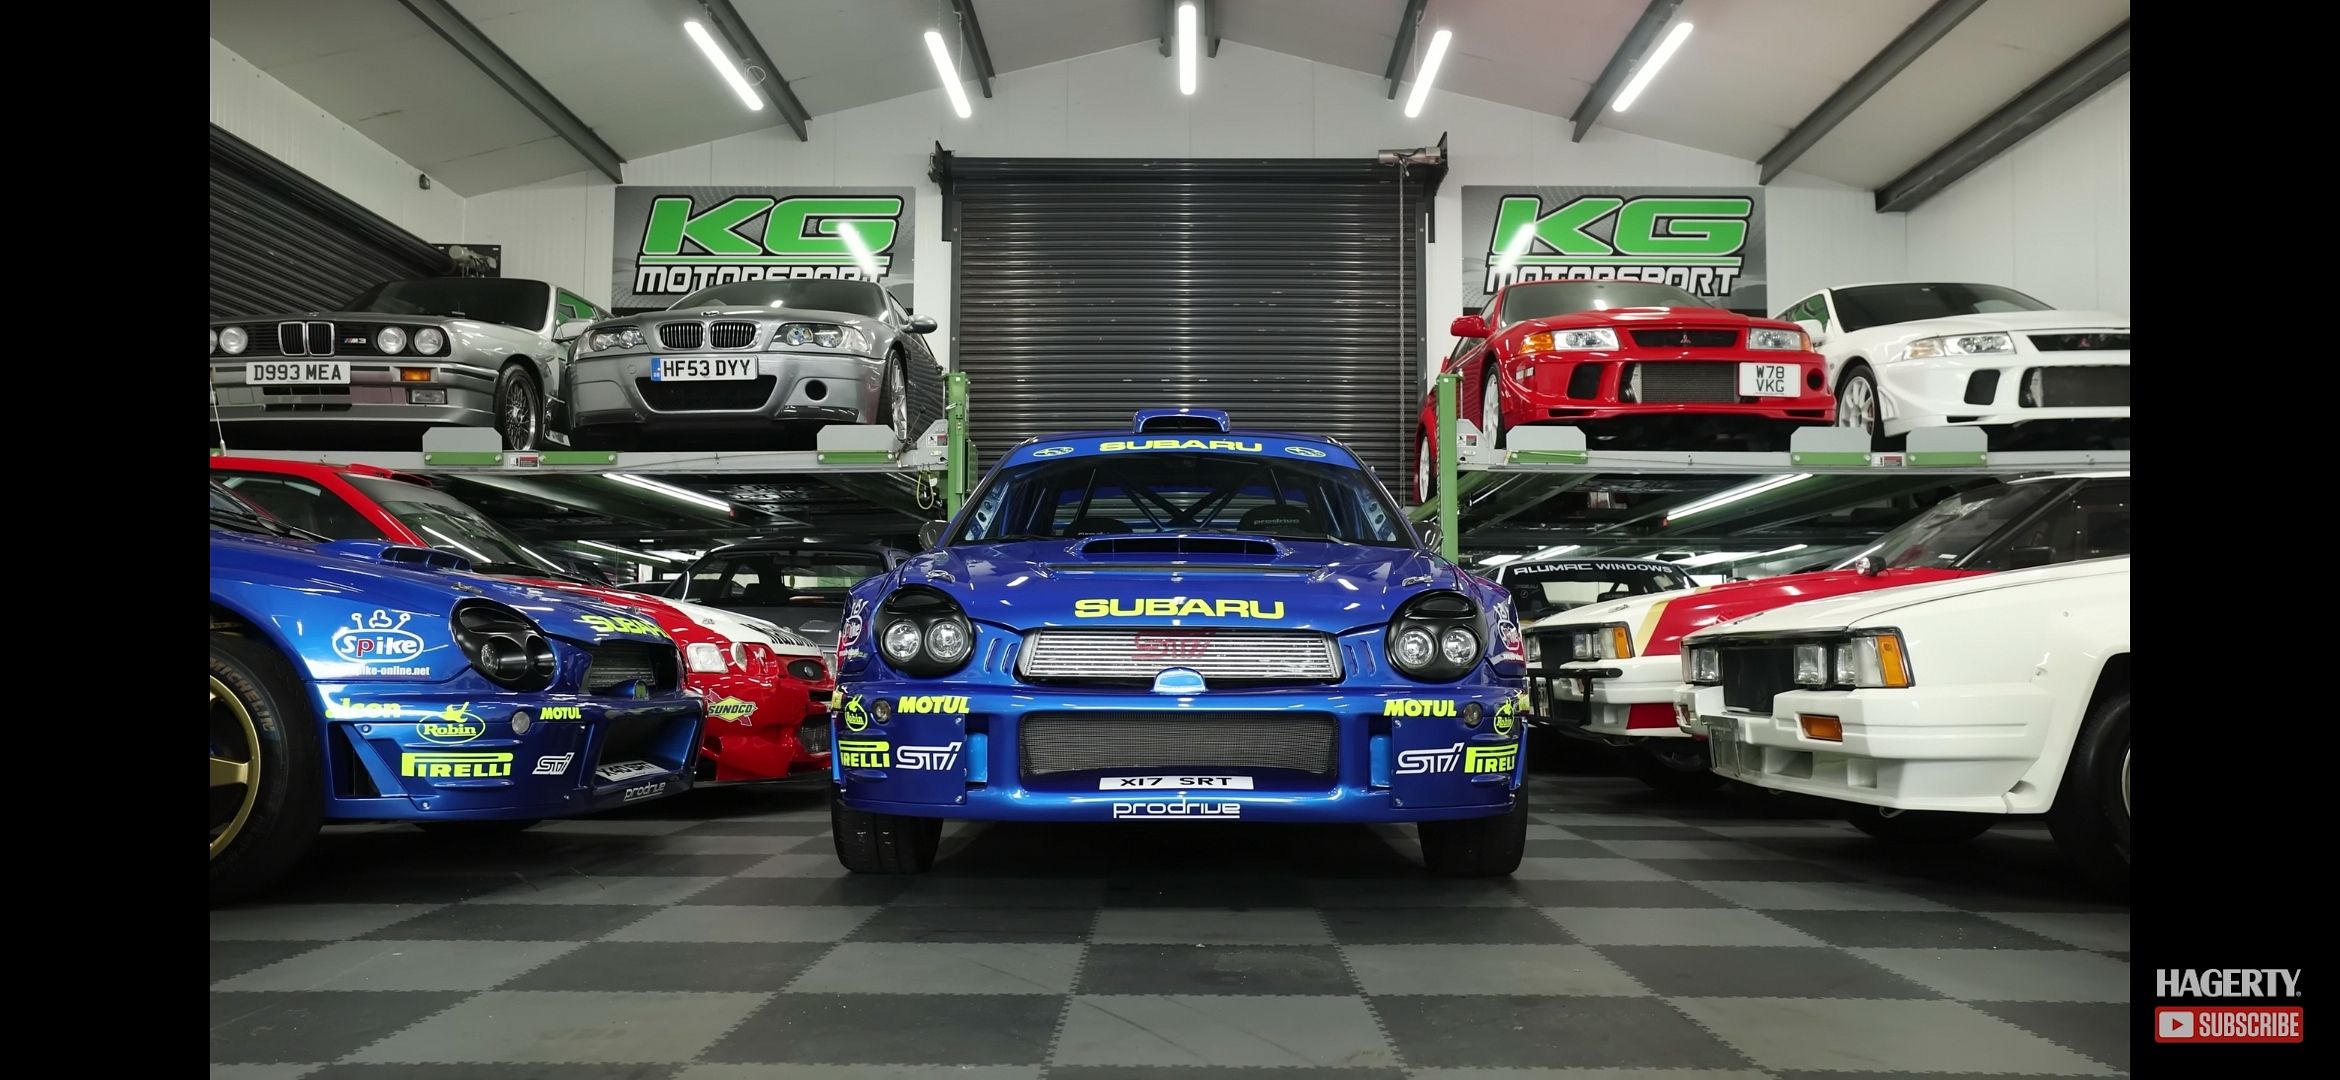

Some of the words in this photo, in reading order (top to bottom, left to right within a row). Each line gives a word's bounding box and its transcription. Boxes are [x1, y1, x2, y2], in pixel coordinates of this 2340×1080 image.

[641, 197, 903, 256] KG
[1490, 197, 1753, 257] KG
[253, 364, 301, 381] D993
[305, 364, 342, 381] MEA
[663, 359, 710, 377] HF53
[715, 358, 751, 375] DYY
[1756, 365, 1785, 379] W78
[1756, 378, 1785, 393] VKG
[1099, 439, 1263, 453] SUBARU
[1513, 563, 1594, 576] ALUMAC
[1595, 563, 1673, 574] WINDOWS
[1074, 597, 1285, 620] SUBARU
[340, 635, 418, 657] Spike
[540, 707, 582, 720] MOTUL
[708, 704, 754, 715] SUNOCO
[897, 696, 970, 714] MOTUL
[1383, 699, 1457, 717] MOTUL
[423, 723, 477, 737] Robin
[401, 752, 514, 777] PIRELLI
[1120, 777, 1163, 787] X17
[1179, 777, 1233, 787] SRT
[623, 781, 666, 802] prodrive
[1113, 797, 1241, 819] prodrive
